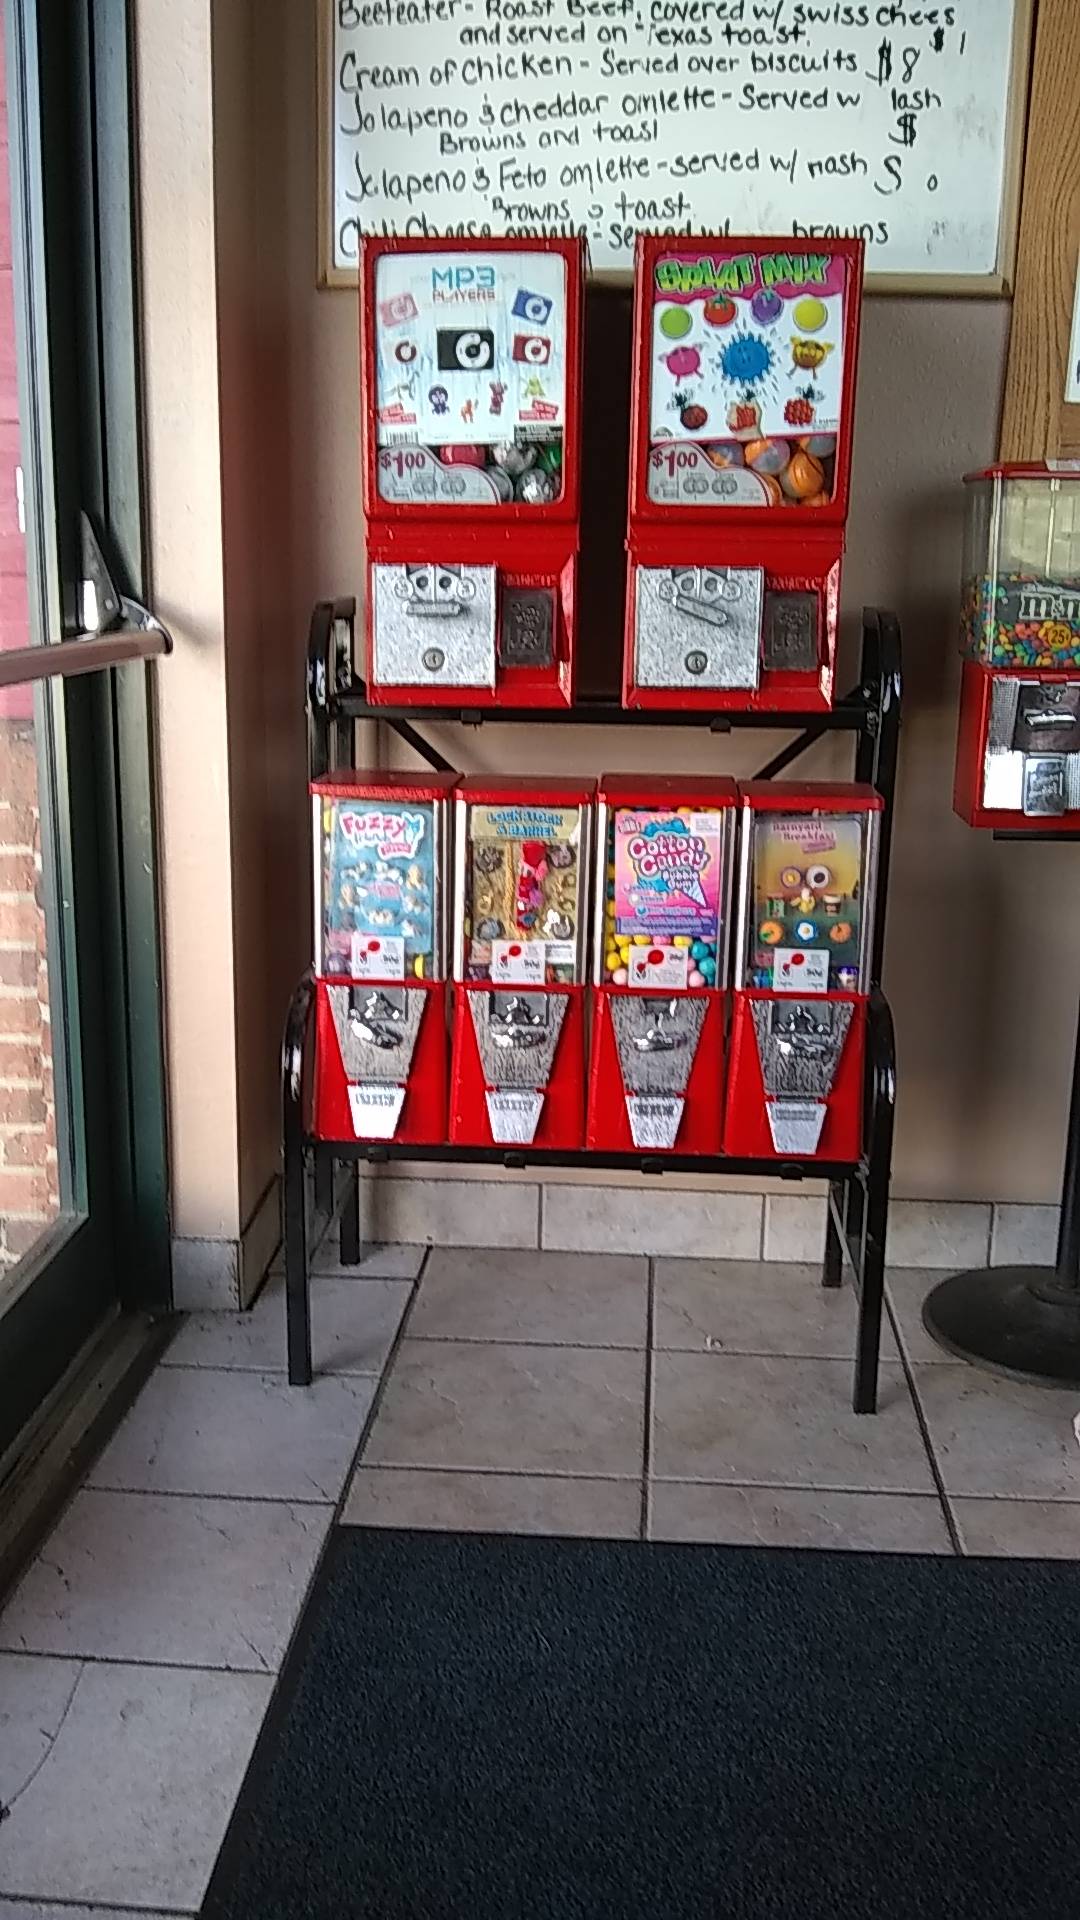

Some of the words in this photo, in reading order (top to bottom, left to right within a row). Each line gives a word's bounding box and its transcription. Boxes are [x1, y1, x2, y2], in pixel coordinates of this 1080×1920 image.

[650, 0, 744, 22] covered
[794, 3, 869, 26] swiss
[460, 22, 501, 46] and
[507, 20, 585, 45] served
[597, 25, 627, 44] on
[339, 50, 420, 94] Cream
[430, 58, 458, 86] of
[687, 54, 740, 74] over
[500, 90, 608, 127] cheddar
[440, 131, 526, 156] Browns
[538, 124, 580, 148] and
[432, 266, 496, 290] MP3
[655, 254, 754, 293] SPLAT
[759, 251, 829, 287] MIX
[629, 835, 703, 860] Cotton
[641, 848, 708, 876] Candy
